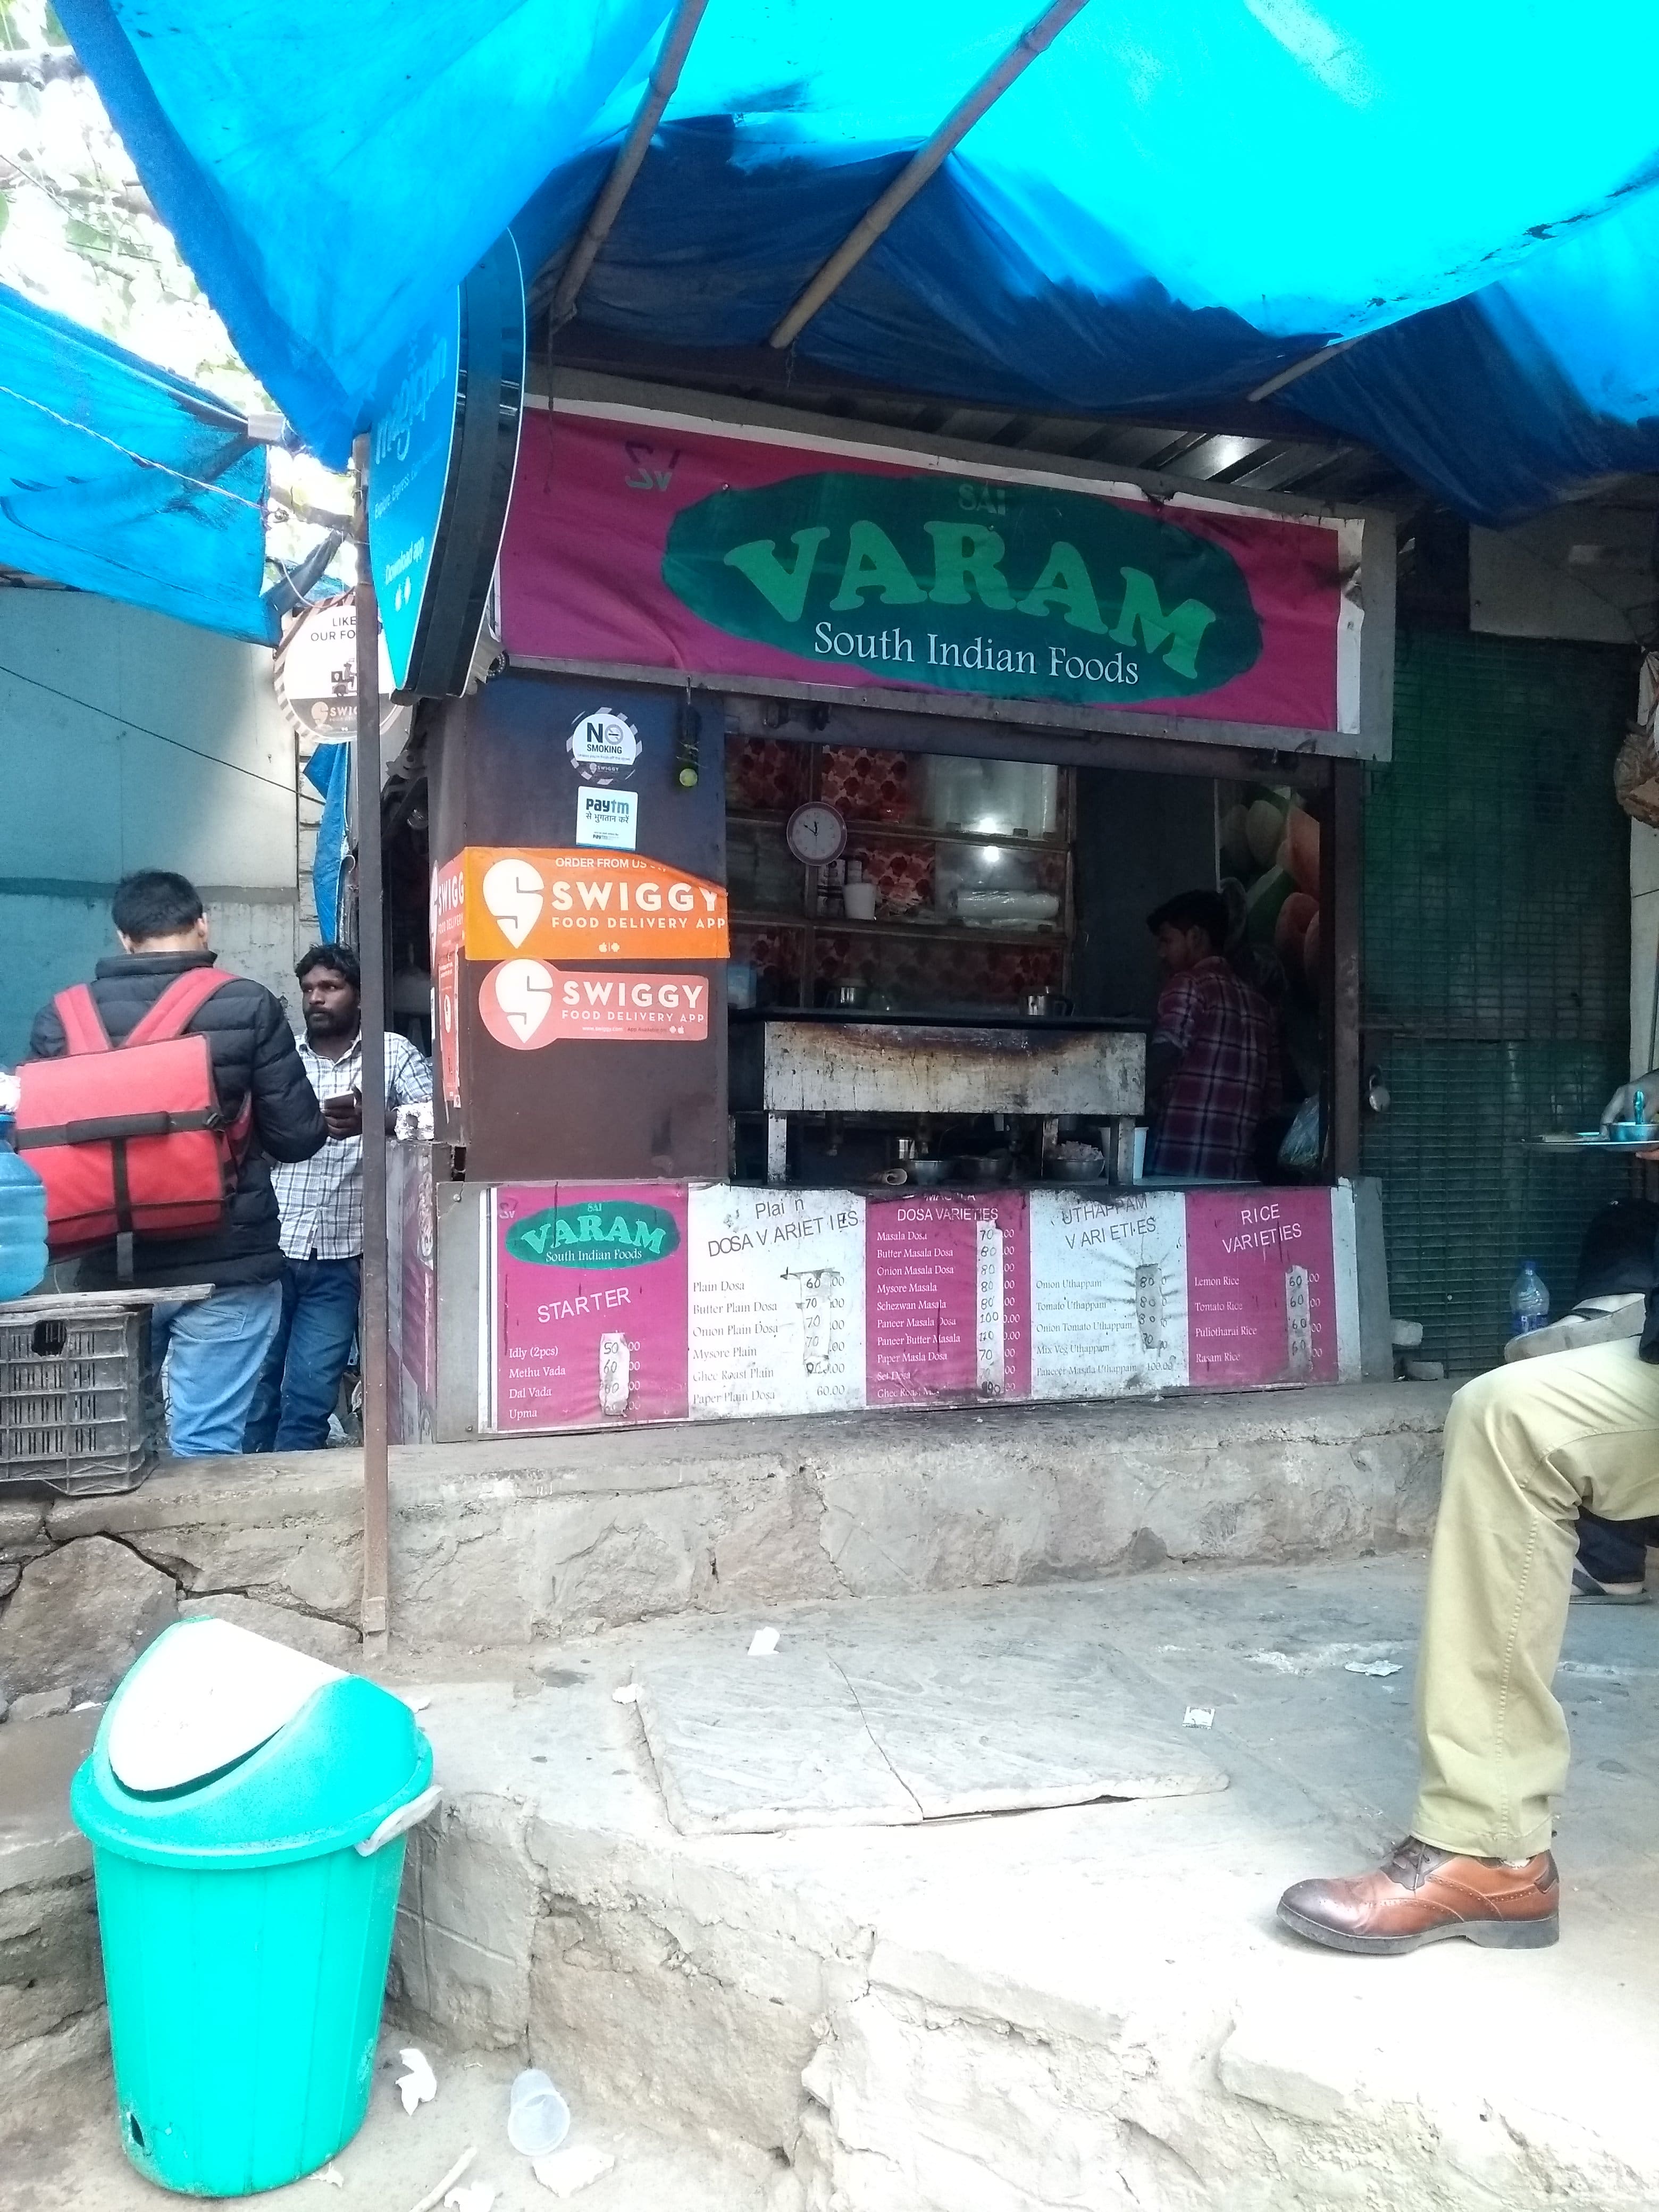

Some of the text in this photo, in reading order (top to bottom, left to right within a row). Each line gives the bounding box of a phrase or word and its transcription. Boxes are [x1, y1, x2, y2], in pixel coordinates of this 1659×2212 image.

[958, 481, 1007, 516] SAI
[413, 536, 425, 563] app
[723, 520, 1217, 680] VARAM
[332, 616, 357, 627] LIKE
[311, 630, 356, 641] OUR FO
[814, 621, 1140, 686] South Indian Foods
[330, 706, 357, 716] SWI
[586, 743, 622, 754] SMOKING
[586, 798, 629, 815] paytm
[585, 811, 629, 824] से भुगतान करें
[556, 857, 594, 868] ORDER
[597, 858, 629, 868] FROM
[632, 859, 647, 868] US
[438, 871, 464, 916] SWIGG
[551, 881, 717, 912] SWIGGY
[551, 917, 726, 929] FOOD DELIVERY APP
[562, 981, 703, 1009] SWIGGY
[562, 1010, 705, 1023] FOOD DELIVERY APP
[587, 1203, 602, 1212] SAI
[898, 1208, 998, 1221] DOSA VARIETIES
[1061, 1197, 1147, 1225] UTHAPPAM
[1241, 1203, 1280, 1225] RICE
[521, 1216, 666, 1254] VARAM
[877, 1231, 906, 1241] Masala
[907, 1231, 927, 1240] Dosa
[979, 1229, 993, 1241] 70
[1066, 1216, 1156, 1250] VARIETIES
[1222, 1223, 1302, 1253] VARIETIES
[708, 1234, 753, 1257] DOSA
[877, 1249, 902, 1259] Butter
[904, 1248, 932, 1258] Masala
[934, 1248, 953, 1257] Dosa
[981, 1246, 996, 1257] 80
[546, 1248, 642, 1262] South Indian Foods
[877, 1266, 902, 1276] Onion
[904, 1265, 933, 1275] Masala
[935, 1265, 954, 1274] Dosa
[981, 1264, 995, 1275] 80
[693, 1281, 717, 1292] Plain
[721, 1281, 744, 1291] Dosa
[806, 1278, 820, 1288] 60
[877, 1281, 993, 1294] Mysore Masala 80
[1036, 1277, 1154, 1289] Onion Uthappam 80
[1195, 1277, 1221, 1286] Lemon
[1223, 1277, 1239, 1285] Rice
[1289, 1276, 1302, 1286] 60
[537, 1287, 631, 1323] STARTER
[693, 1298, 817, 1315] Butter Plain Dosa 70
[877, 1297, 993, 1310] Schezwan Masala 80
[1036, 1296, 1155, 1311] Tomato Uthappam 80
[1195, 1294, 1303, 1311] Tomato Rice 60
[693, 1327, 725, 1337] Onion
[727, 1326, 751, 1335] Plain
[755, 1323, 778, 1334] Dosa
[806, 1315, 820, 1328] 70
[877, 1318, 904, 1328] Paneer
[906, 1317, 934, 1327] Masala
[937, 1317, 956, 1326] Dosa
[980, 1312, 999, 1323] 100
[1036, 1313, 1155, 1332] Onion Tomato Uthappam 80
[1195, 1319, 1306, 1337] Puliotharai Rice 60
[877, 1333, 961, 1346] Paneer Butter Masala
[509, 1342, 618, 1359] Idly (2pcs) 50
[693, 1349, 730, 1361] Mysore
[733, 1347, 757, 1358] Plain
[806, 1336, 819, 1347] 70
[1036, 1343, 1110, 1354] Mix Veg Uthappam
[1196, 1340, 1305, 1362] Rasam Rice 60
[877, 1349, 992, 1364] Paper Masla Dosa 70
[509, 1359, 617, 1378] Methu Vada 60
[693, 1368, 774, 1382] Ghee Roast Plain
[877, 1370, 911, 1380] Set Dosa
[1068, 1366, 1096, 1376] Masala
[1097, 1364, 1136, 1375] Uthappam
[509, 1388, 526, 1399] Dal
[529, 1386, 552, 1397] Vada
[693, 1385, 845, 1405] Paper Plain Dosa 60.00
[877, 1388, 899, 1399] Ghee
[509, 1409, 537, 1420] Upma
